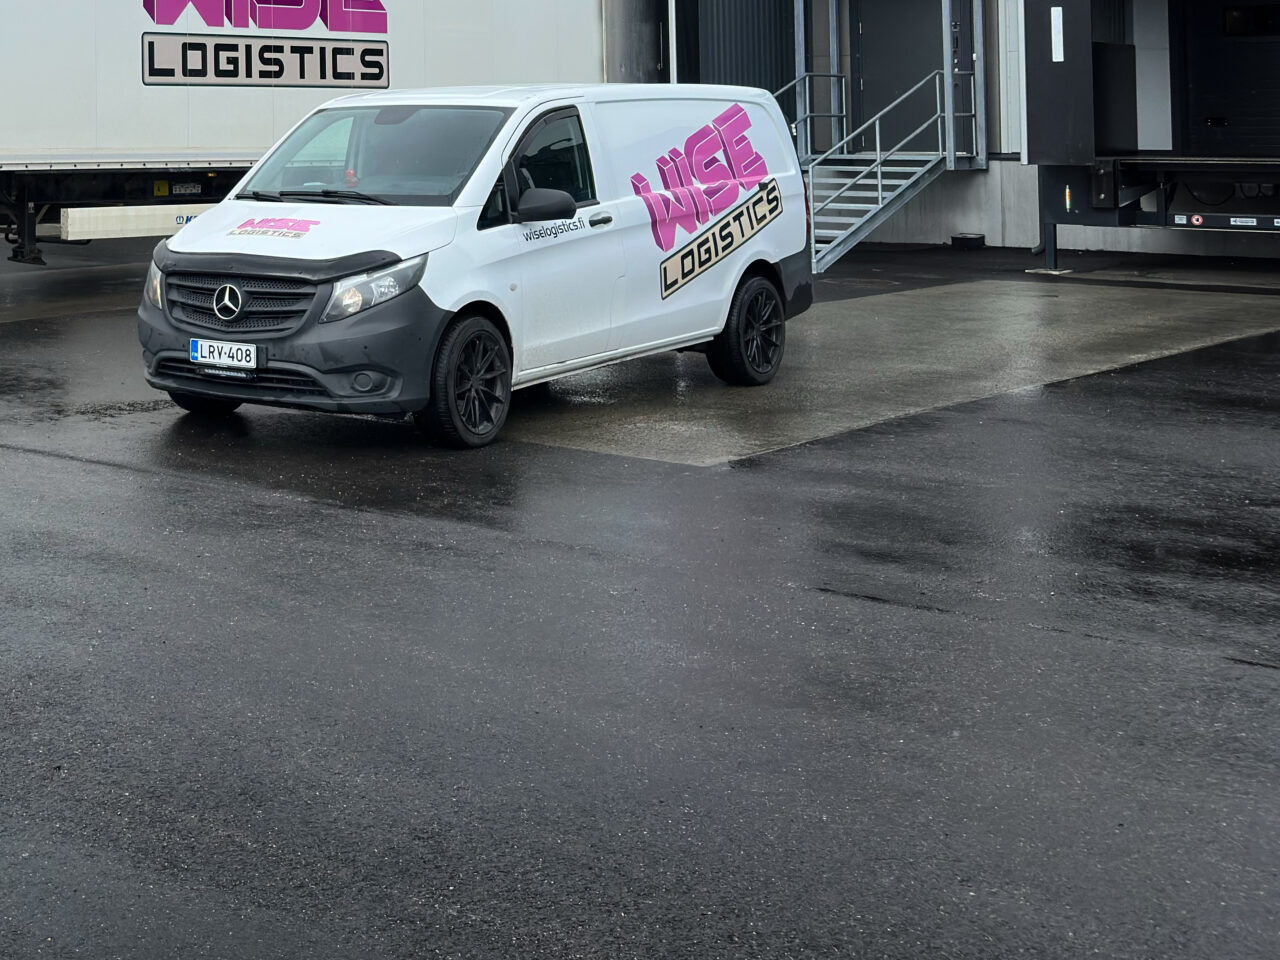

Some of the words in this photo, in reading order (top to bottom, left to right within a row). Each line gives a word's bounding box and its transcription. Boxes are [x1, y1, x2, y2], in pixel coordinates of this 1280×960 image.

[148, 41, 384, 81] LOGISTICS
[630, 103, 768, 253] WISE
[523, 217, 586, 242] wiselogistics.fi
[663, 184, 781, 293] LOGISTICS
